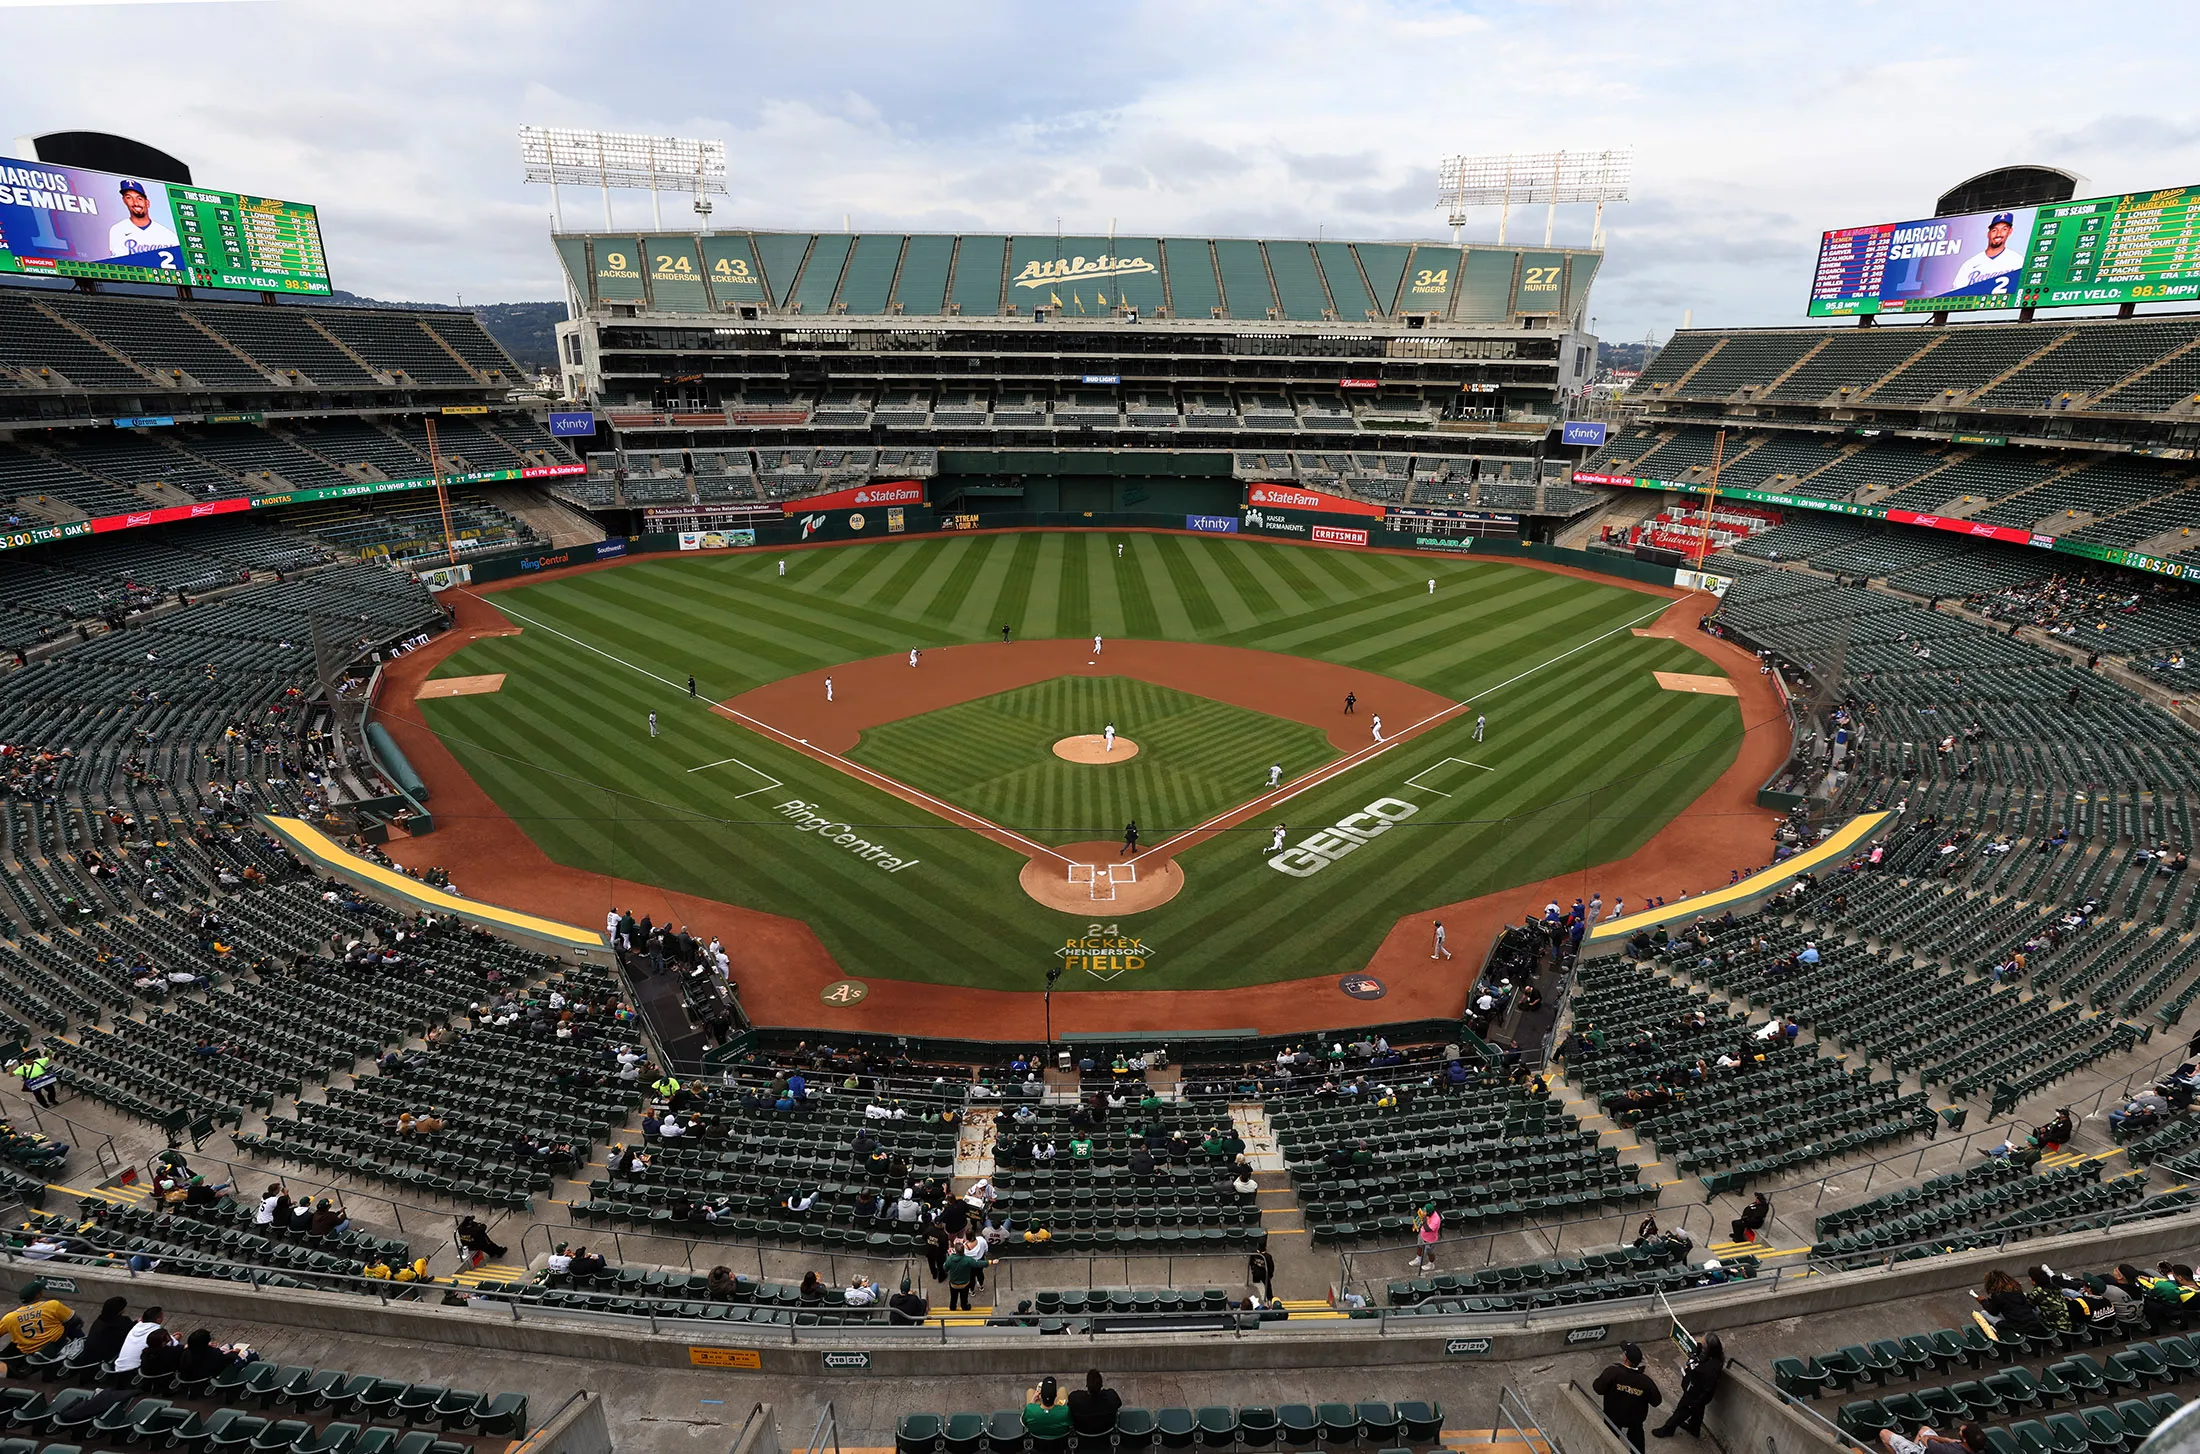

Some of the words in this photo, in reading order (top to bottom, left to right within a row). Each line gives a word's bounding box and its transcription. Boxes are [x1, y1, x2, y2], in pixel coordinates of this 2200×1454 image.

[0, 186, 98, 215] SEMIEN
[184, 190, 198, 201] THIS
[198, 192, 222, 204] SEASON
[2130, 198, 2179, 210] LAUREANO
[250, 211, 276, 220] LOWRIE
[2054, 208, 2070, 218] THIS
[2070, 204, 2096, 216] SEASON
[2128, 208, 2164, 218] LOWRIE
[252, 218, 276, 226] PINDER
[2125, 218, 2158, 226] PINDER
[254, 225, 280, 234] MURPHY
[1892, 224, 1947, 245] MARCUS
[2122, 224, 2162, 234] MURPHY
[2118, 238, 2176, 250] BETHANCOURT
[2120, 234, 2150, 242] NEUSE
[1888, 240, 1962, 260] SEMIEN
[2116, 249, 2152, 258] ANDRUS
[158, 251, 177, 270] 2
[608, 252, 627, 271] 9
[656, 255, 693, 274] 24
[2114, 258, 2142, 266] SMITH
[262, 268, 290, 276] MONTAS
[714, 258, 750, 276] 43
[1013, 254, 1150, 284] Athletics
[2110, 266, 2140, 274] PACHE
[598, 270, 640, 279] JACKSON
[652, 272, 701, 282] HENDERSON
[711, 276, 758, 284] ECKERSLEY
[1415, 269, 1448, 286] 34
[1525, 267, 1561, 284] 27
[2108, 274, 2146, 283] MONTAS
[222, 275, 246, 285] EXIT
[248, 276, 279, 288] VELO:
[1991, 276, 2010, 294] 2
[1524, 284, 1558, 292] HUNTER
[2052, 290, 2082, 301] EXIT
[2083, 288, 2122, 300] VELO:
[1825, 302, 1844, 310] 95.8
[1341, 379, 1377, 388] Budweiser
[132, 418, 158, 427] Corona
[556, 418, 588, 430] xfinity
[1568, 426, 1600, 440] xfinity
[556, 466, 585, 474] StateFarm
[1582, 474, 1608, 484] StateFarm
[262, 496, 292, 505] MONTAS
[870, 489, 920, 502] StateFarm
[1266, 490, 1320, 507] StateFarm
[954, 514, 979, 523] STREAM
[1194, 516, 1230, 532] xfinity
[1266, 515, 1286, 523] KAISER
[37, 530, 54, 540] TEX
[64, 525, 84, 536] OAK
[1266, 522, 1304, 532] PERMANENTE
[1315, 530, 1364, 542] CRAFTSMAN
[1656, 531, 1703, 547] Budweiser
[597, 544, 622, 554] Southwest
[2028, 540, 2053, 550] ATHLETICS
[520, 552, 569, 570] RingCentral
[434, 571, 448, 582] 811
[1706, 576, 1718, 586] 811
[772, 799, 920, 873] RingCentral
[1268, 797, 1420, 878] GEICO
[1087, 923, 1120, 937] 24
[1066, 938, 1142, 949] RICKEY
[1065, 948, 1145, 956] HENDERSON
[1065, 956, 1146, 970] FIELD
[824, 984, 862, 1002] A's
[1076, 1148, 1087, 1156] 26
[17, 1310, 42, 1323] BUSH
[21, 1320, 44, 1339] 51
